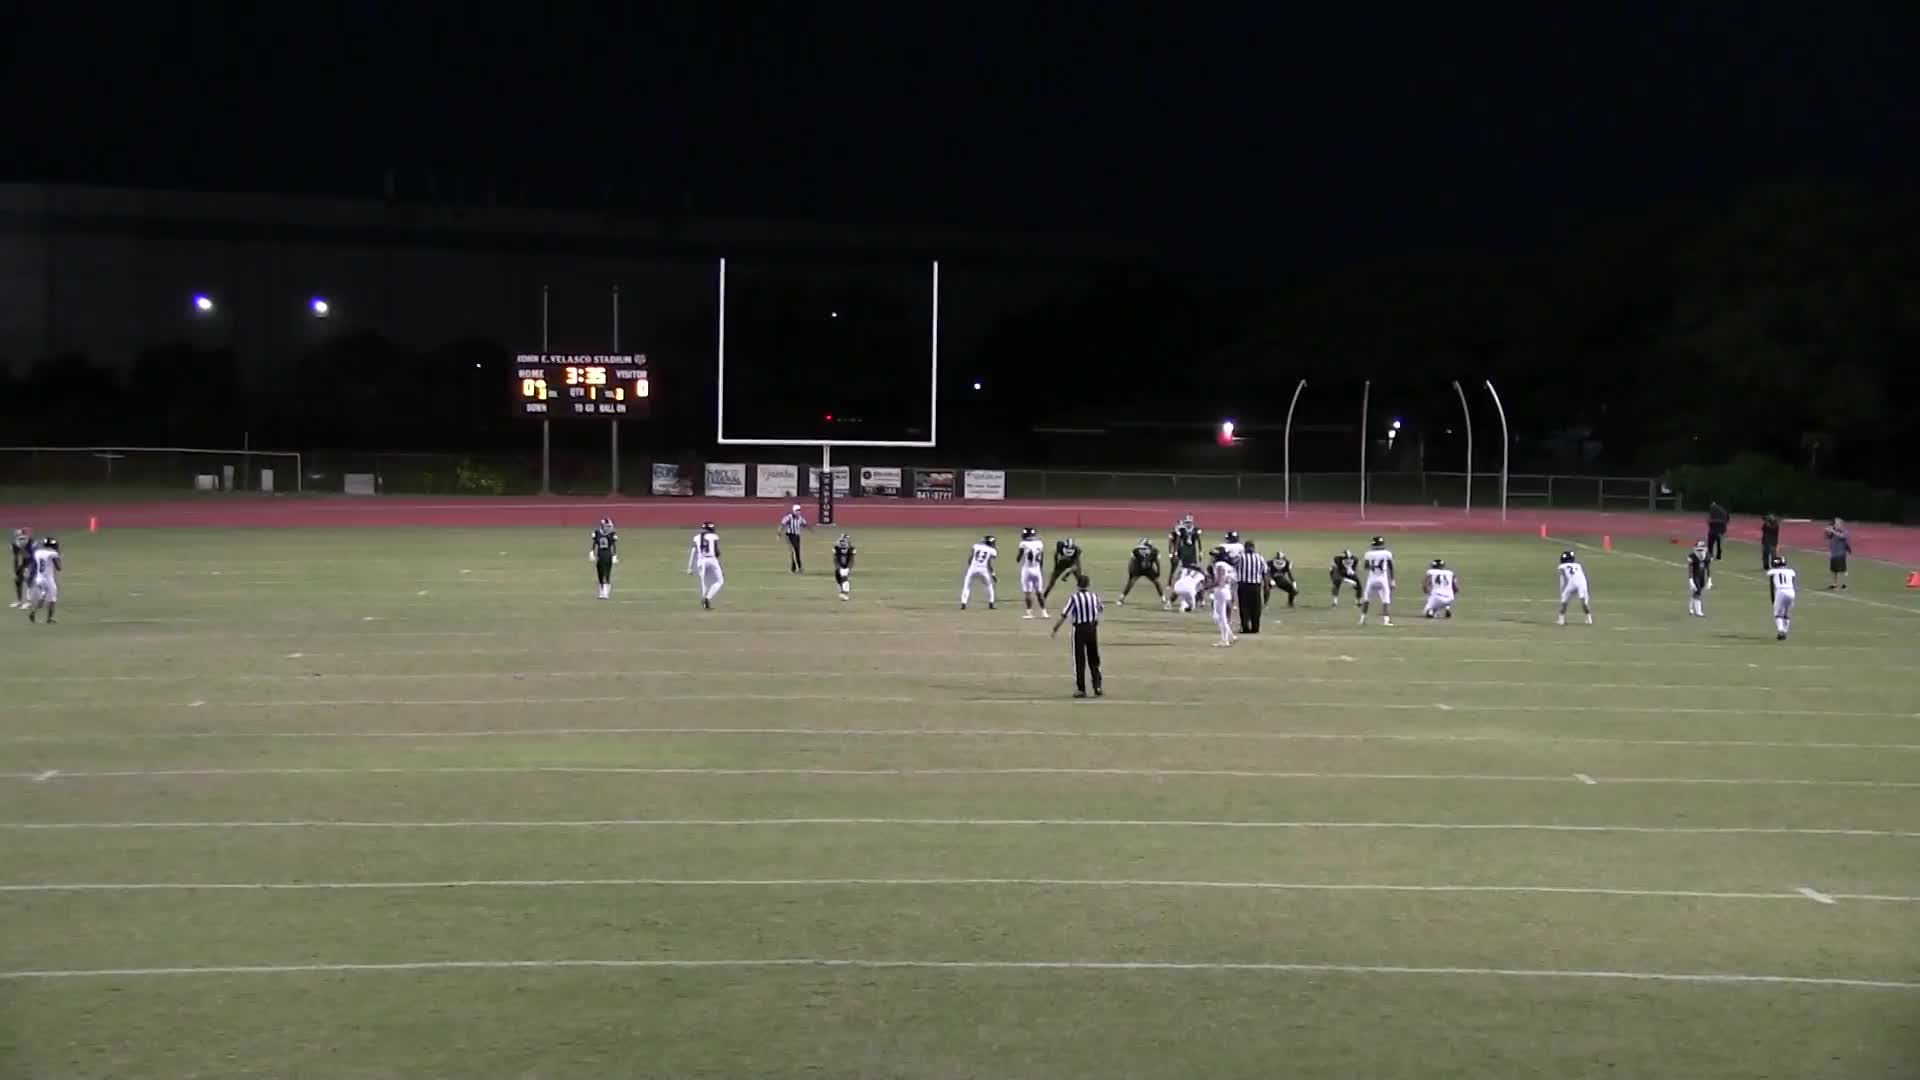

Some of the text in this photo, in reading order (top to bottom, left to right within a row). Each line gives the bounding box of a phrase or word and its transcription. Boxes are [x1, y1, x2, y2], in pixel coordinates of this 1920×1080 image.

[550, 355, 592, 364] VELASCO
[593, 355, 632, 364] STADIUM
[518, 369, 544, 378] HOME
[616, 370, 648, 379] VISITOR
[637, 379, 648, 397] 0
